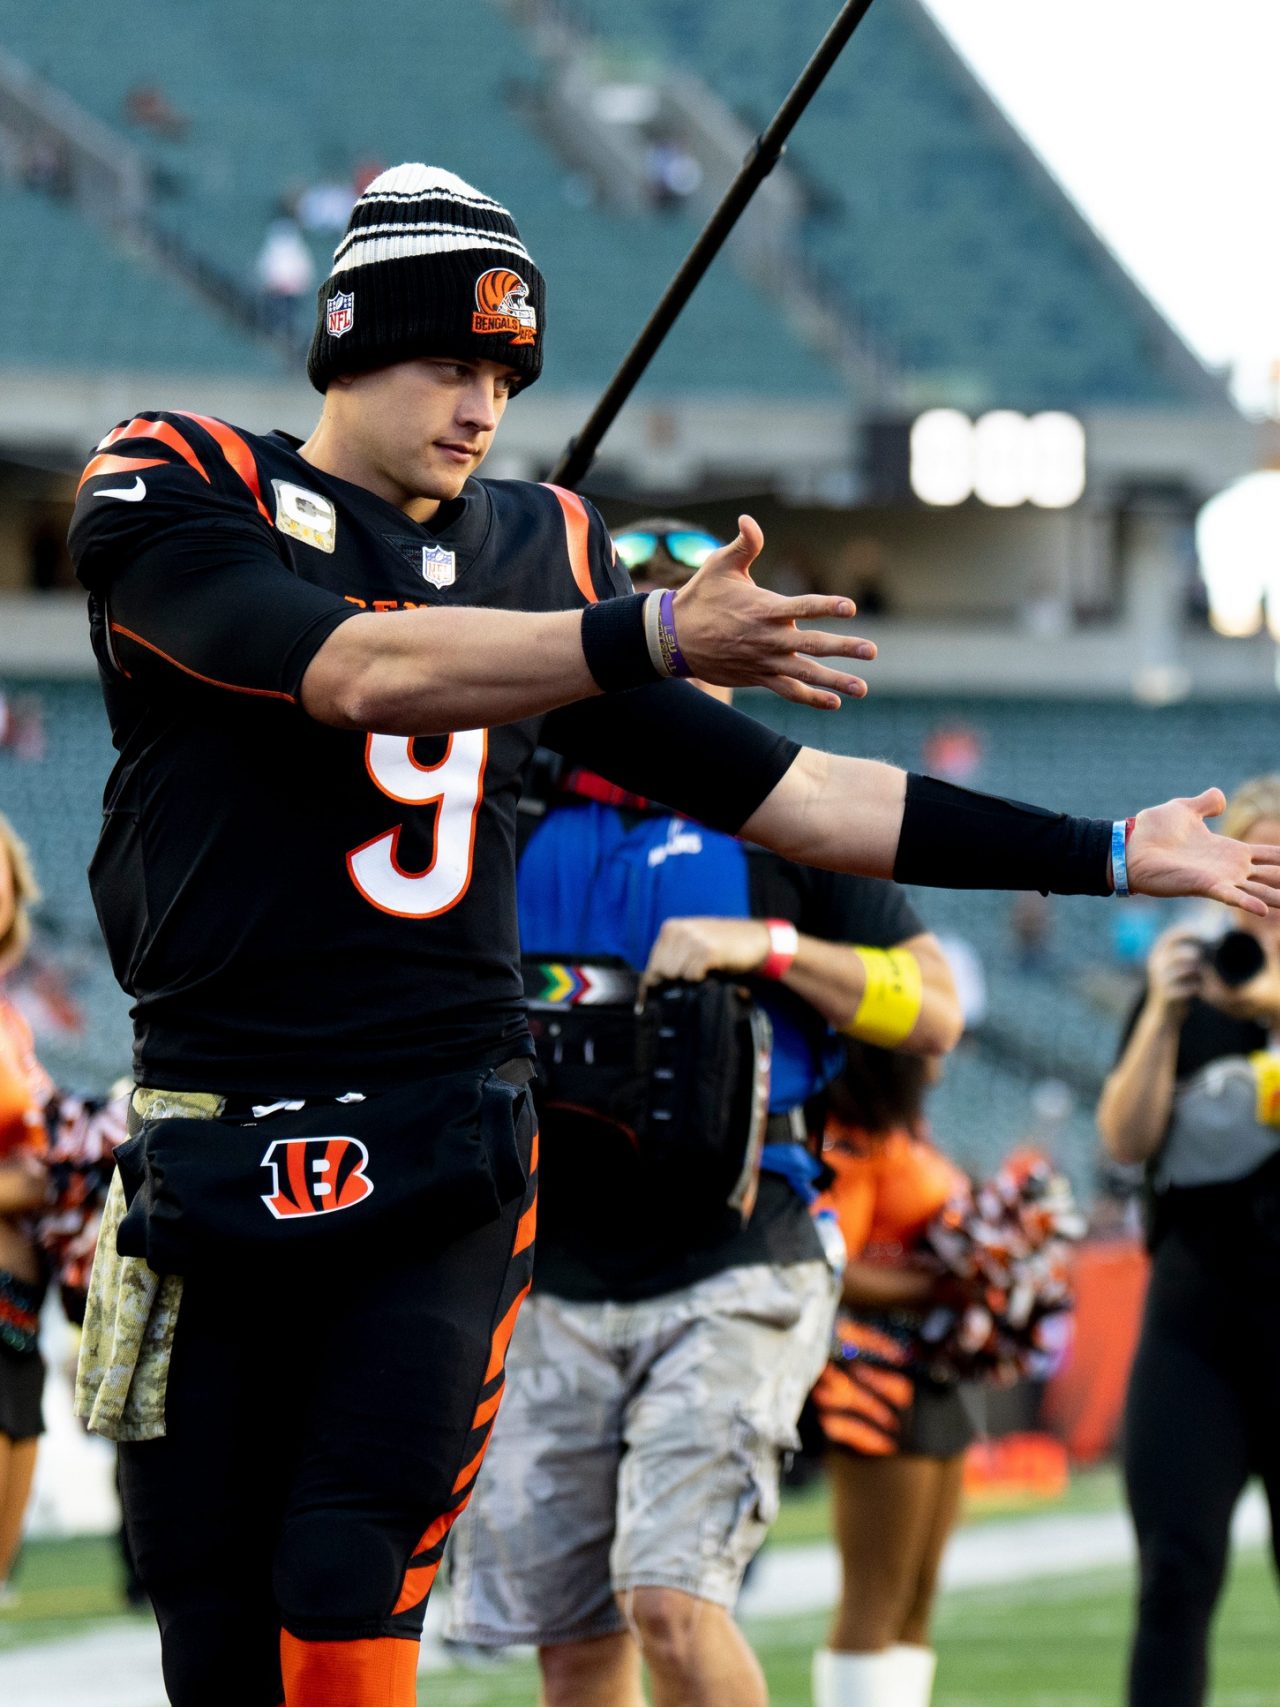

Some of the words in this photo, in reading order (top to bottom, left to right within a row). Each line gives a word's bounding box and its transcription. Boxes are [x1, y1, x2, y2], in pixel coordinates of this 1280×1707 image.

[329, 310, 351, 331] NFL
[475, 315, 518, 331] BENGALS
[346, 728, 488, 919] 9
